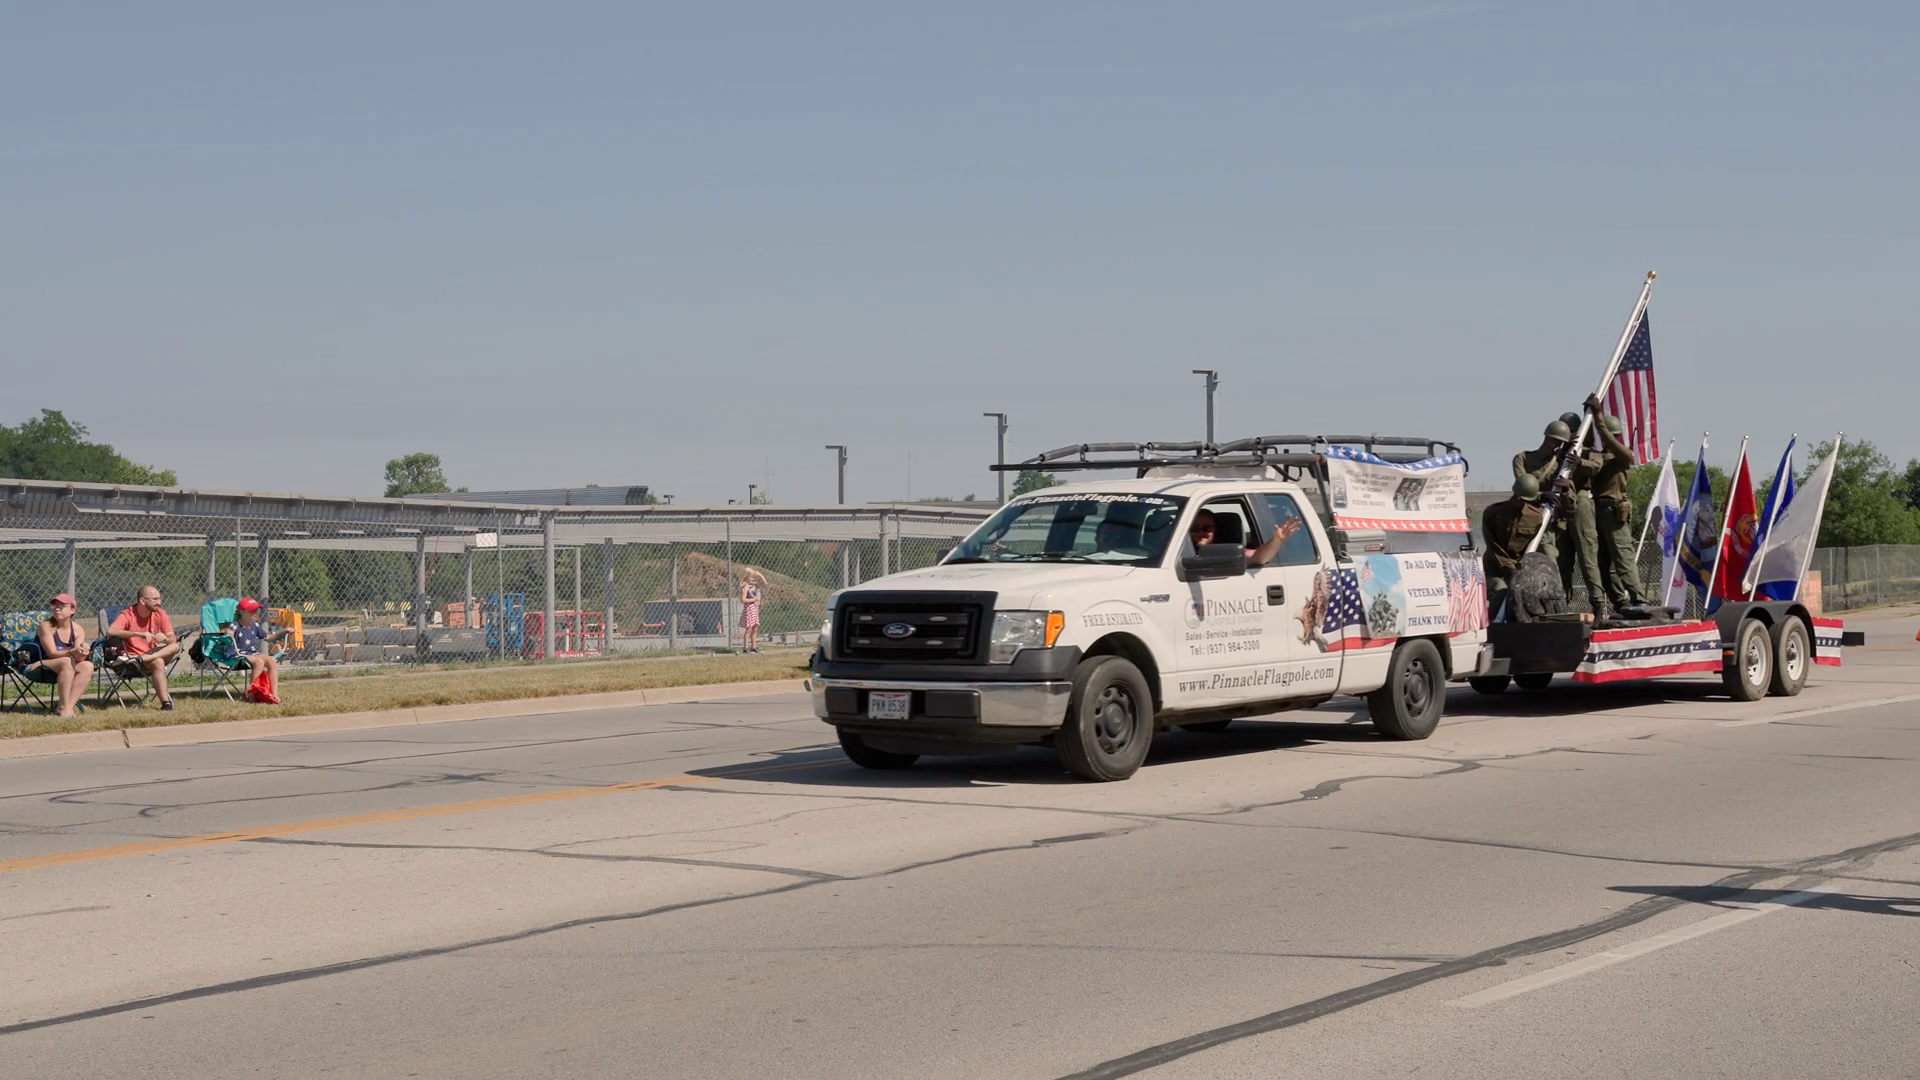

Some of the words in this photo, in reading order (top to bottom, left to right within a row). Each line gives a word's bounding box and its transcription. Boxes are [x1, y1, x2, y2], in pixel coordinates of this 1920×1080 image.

[1404, 560, 1414, 570] To
[1415, 560, 1425, 569] All
[1425, 560, 1437, 569] Our
[1407, 587, 1445, 598] VETERANS
[1207, 596, 1264, 617] PINNACLE
[1082, 614, 1106, 627] FREE
[1105, 612, 1144, 626] ESTIMATES
[1408, 616, 1432, 627] THANK
[887, 625, 906, 634] Ford
[1185, 631, 1202, 641] Sales
[1205, 630, 1228, 640] Service
[1231, 627, 1263, 637] Installation
[1190, 645, 1205, 656] Tel:
[1206, 643, 1226, 655] (937)
[1227, 640, 1260, 653] 964-3300
[1178, 665, 1335, 693] www.PinnacleFlagpole.com
